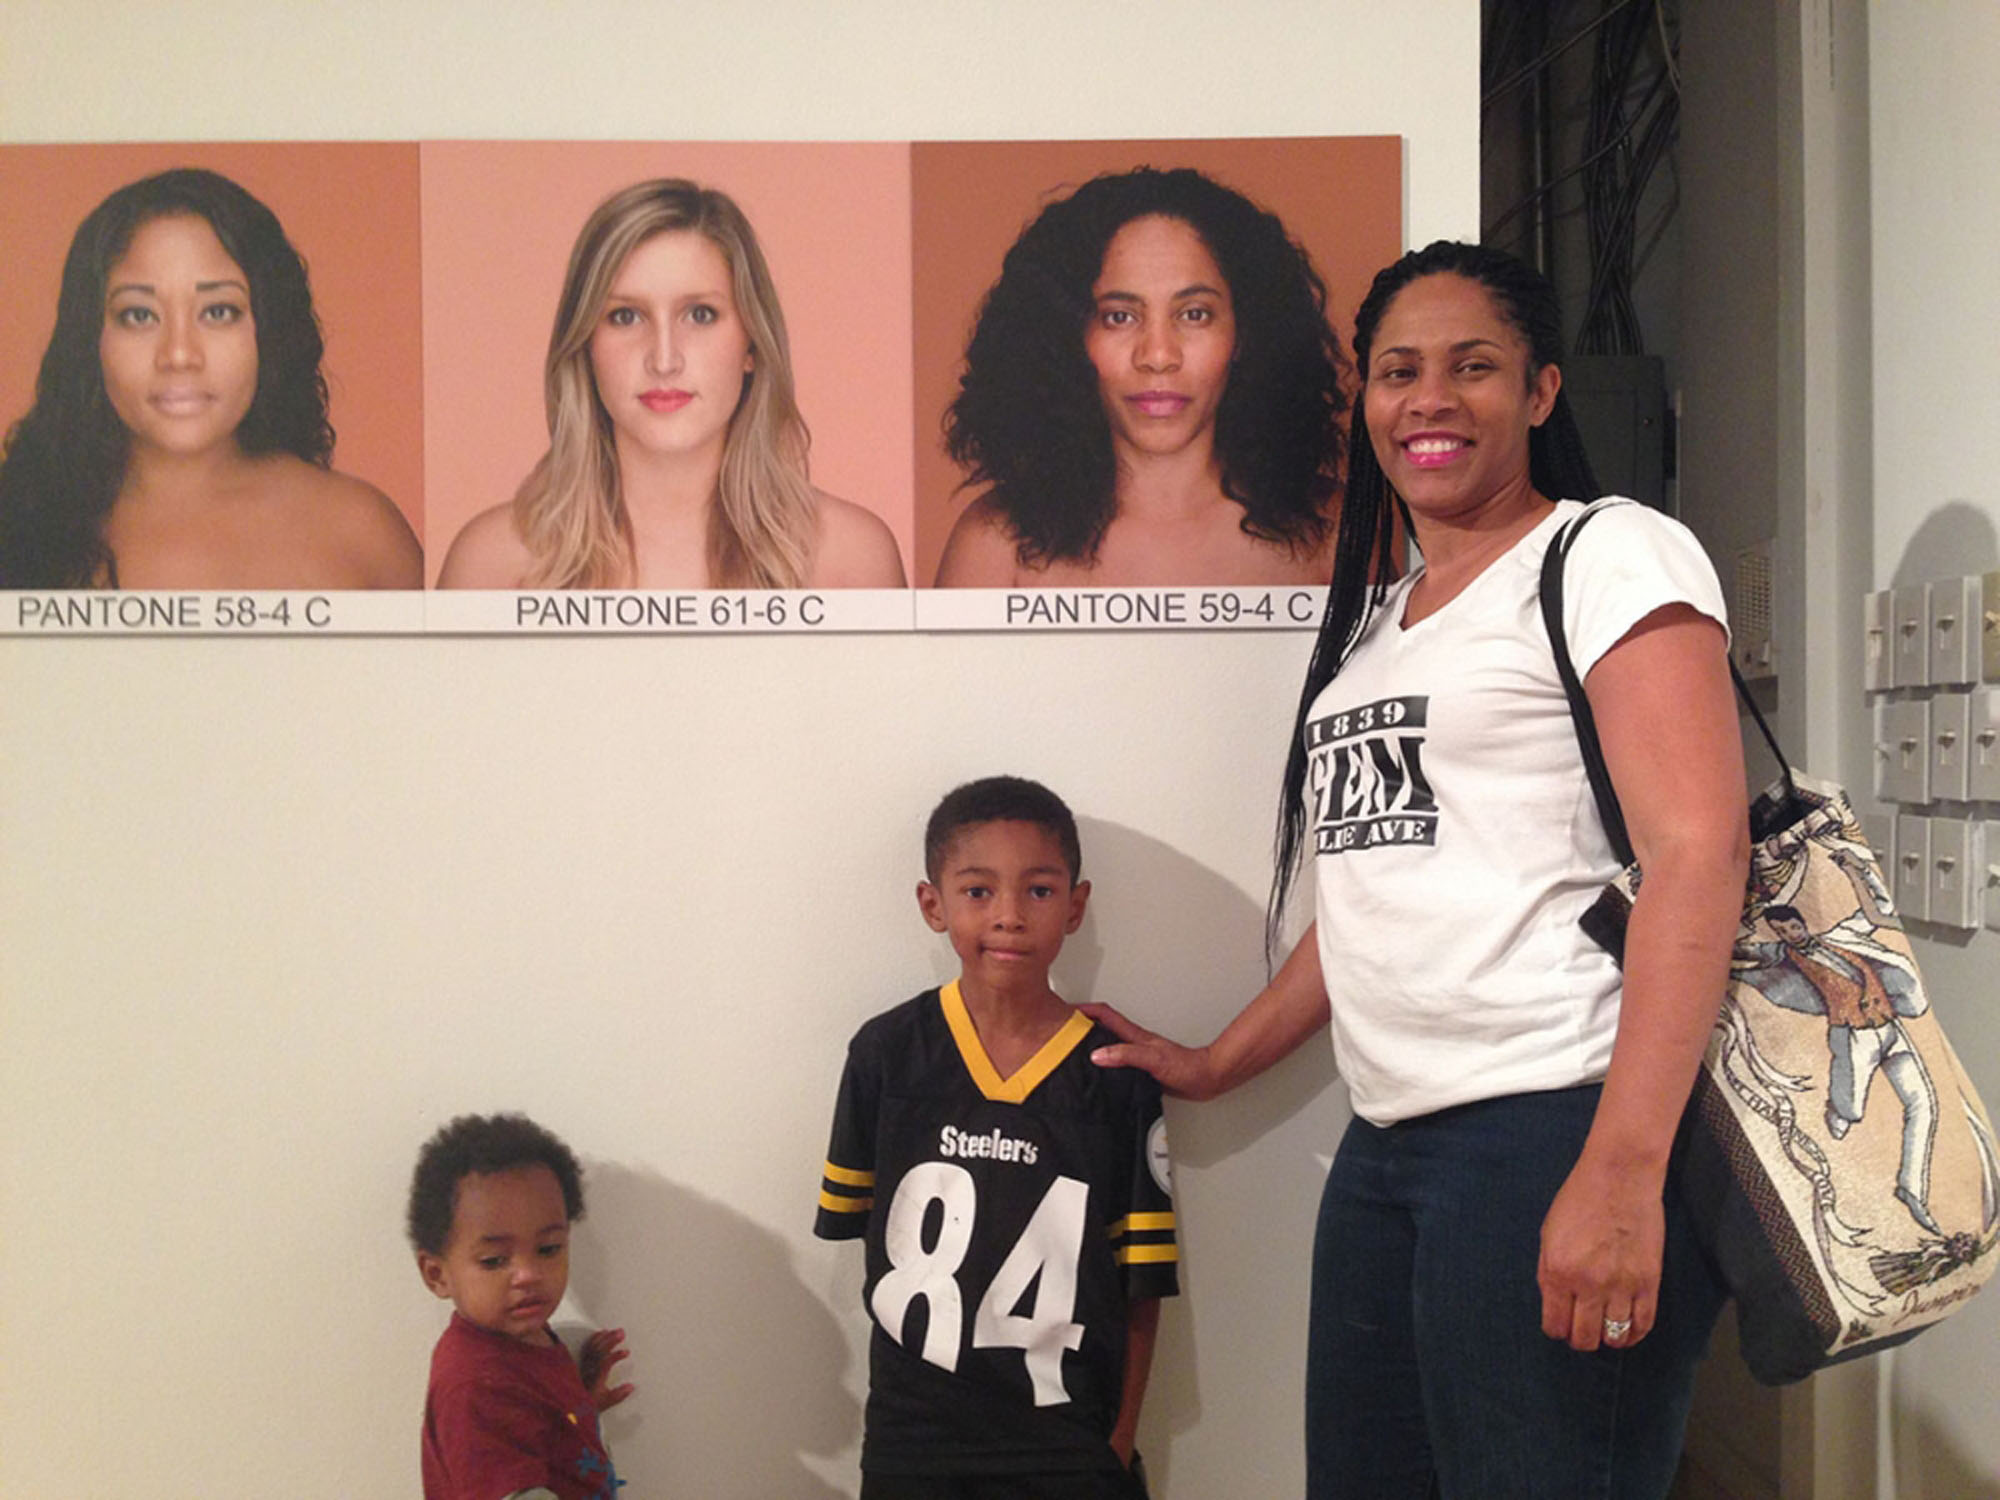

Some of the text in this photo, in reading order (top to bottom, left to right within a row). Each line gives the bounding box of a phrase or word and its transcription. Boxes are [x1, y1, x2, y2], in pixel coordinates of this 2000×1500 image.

[18, 595, 332, 629] PANTONE 58-4 C
[516, 594, 826, 627] PANTONE 61-6 C
[1006, 591, 1314, 624] PANTONE 59-4 C
[1312, 701, 1406, 744] 1839
[1364, 819, 1427, 845] AVE
[940, 1125, 1039, 1165] Steelers
[871, 1161, 1089, 1407] 84
